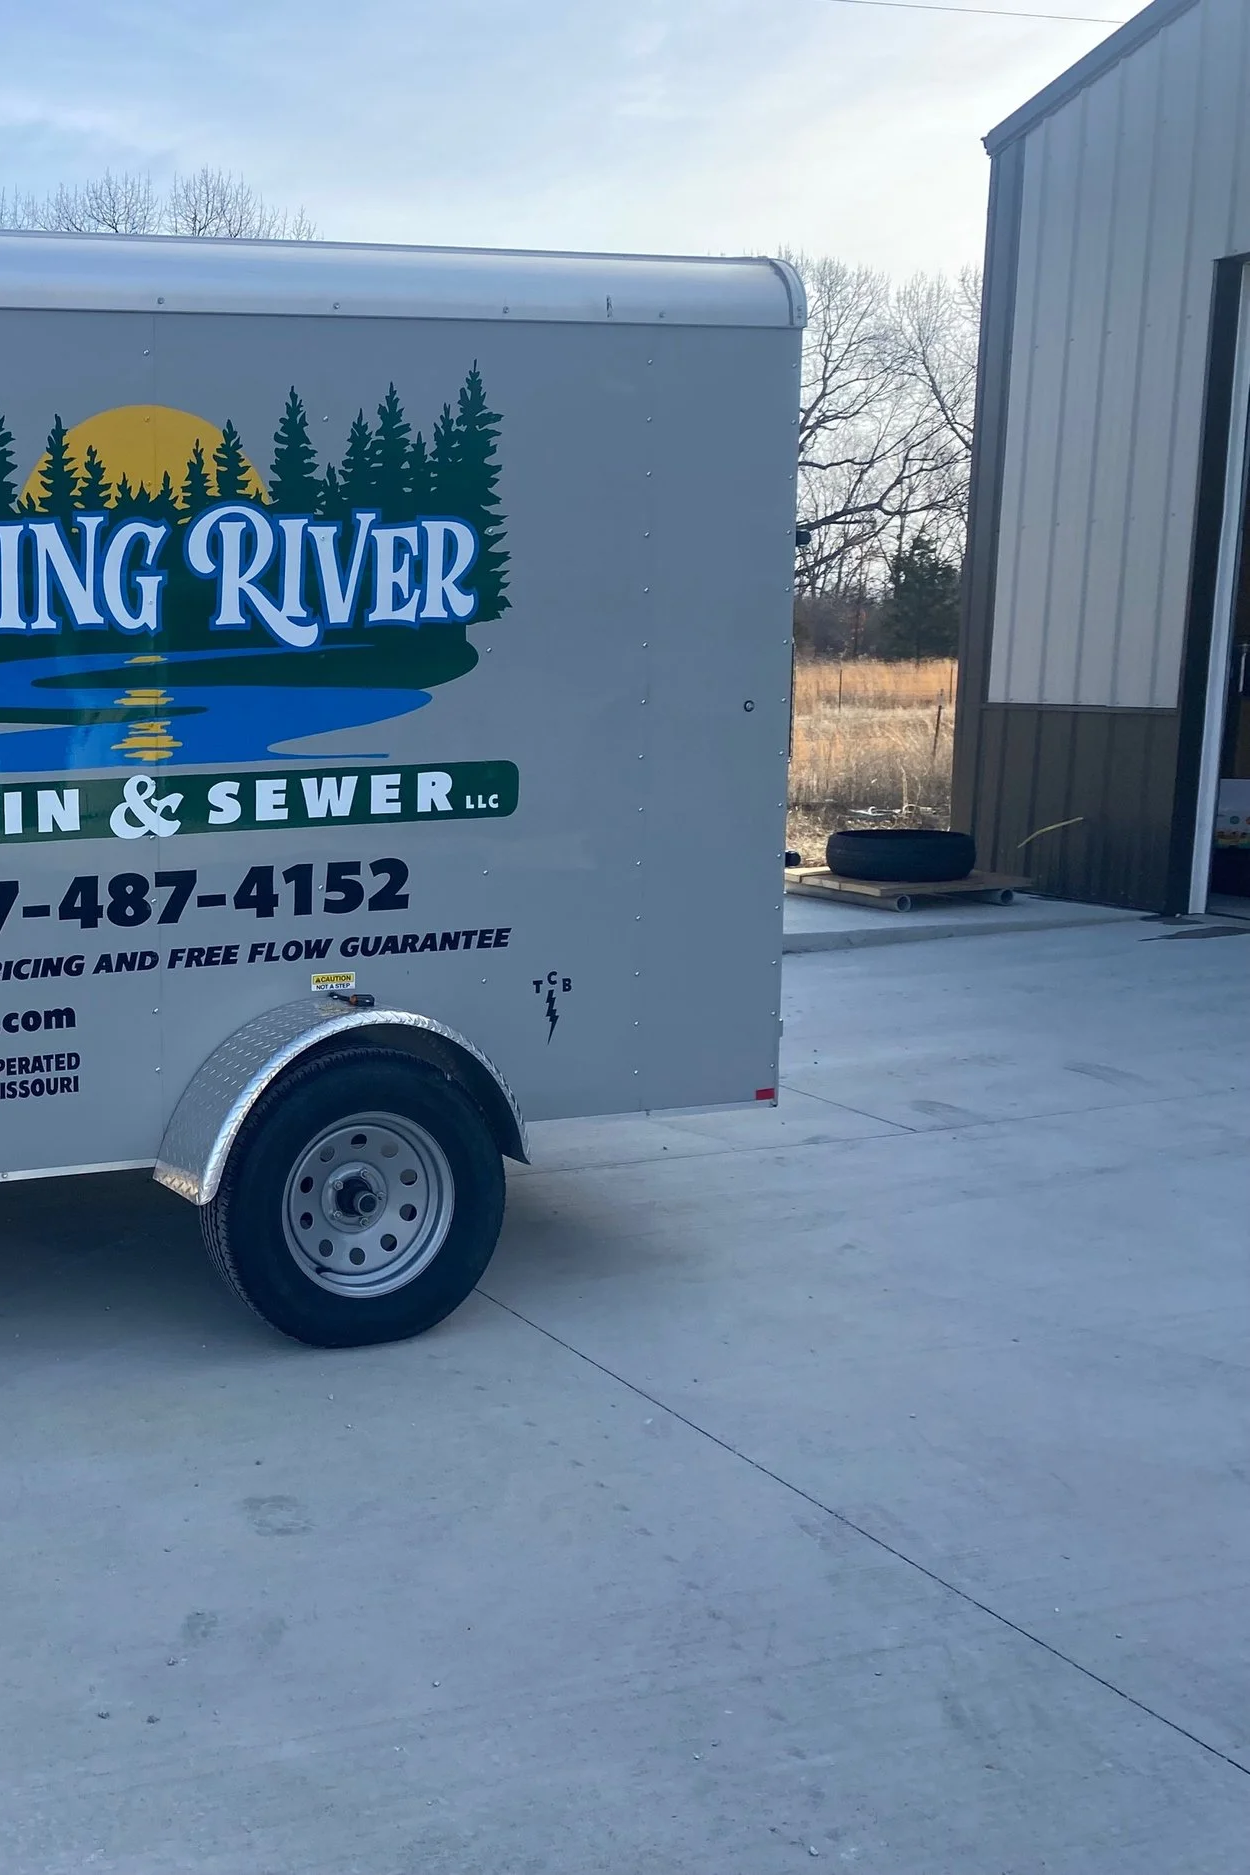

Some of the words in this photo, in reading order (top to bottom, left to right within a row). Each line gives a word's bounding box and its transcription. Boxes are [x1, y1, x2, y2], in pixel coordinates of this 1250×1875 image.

[188, 506, 478, 647] RIVER
[109, 774, 181, 838] &
[208, 772, 454, 822] SEWER
[466, 793, 499, 810] LLC
[92, 950, 160, 975] AND
[167, 943, 240, 970] FREE
[247, 938, 334, 963] FLOW
[340, 927, 512, 958] GUARANTEE
[320, 975, 351, 983] CAUTION
